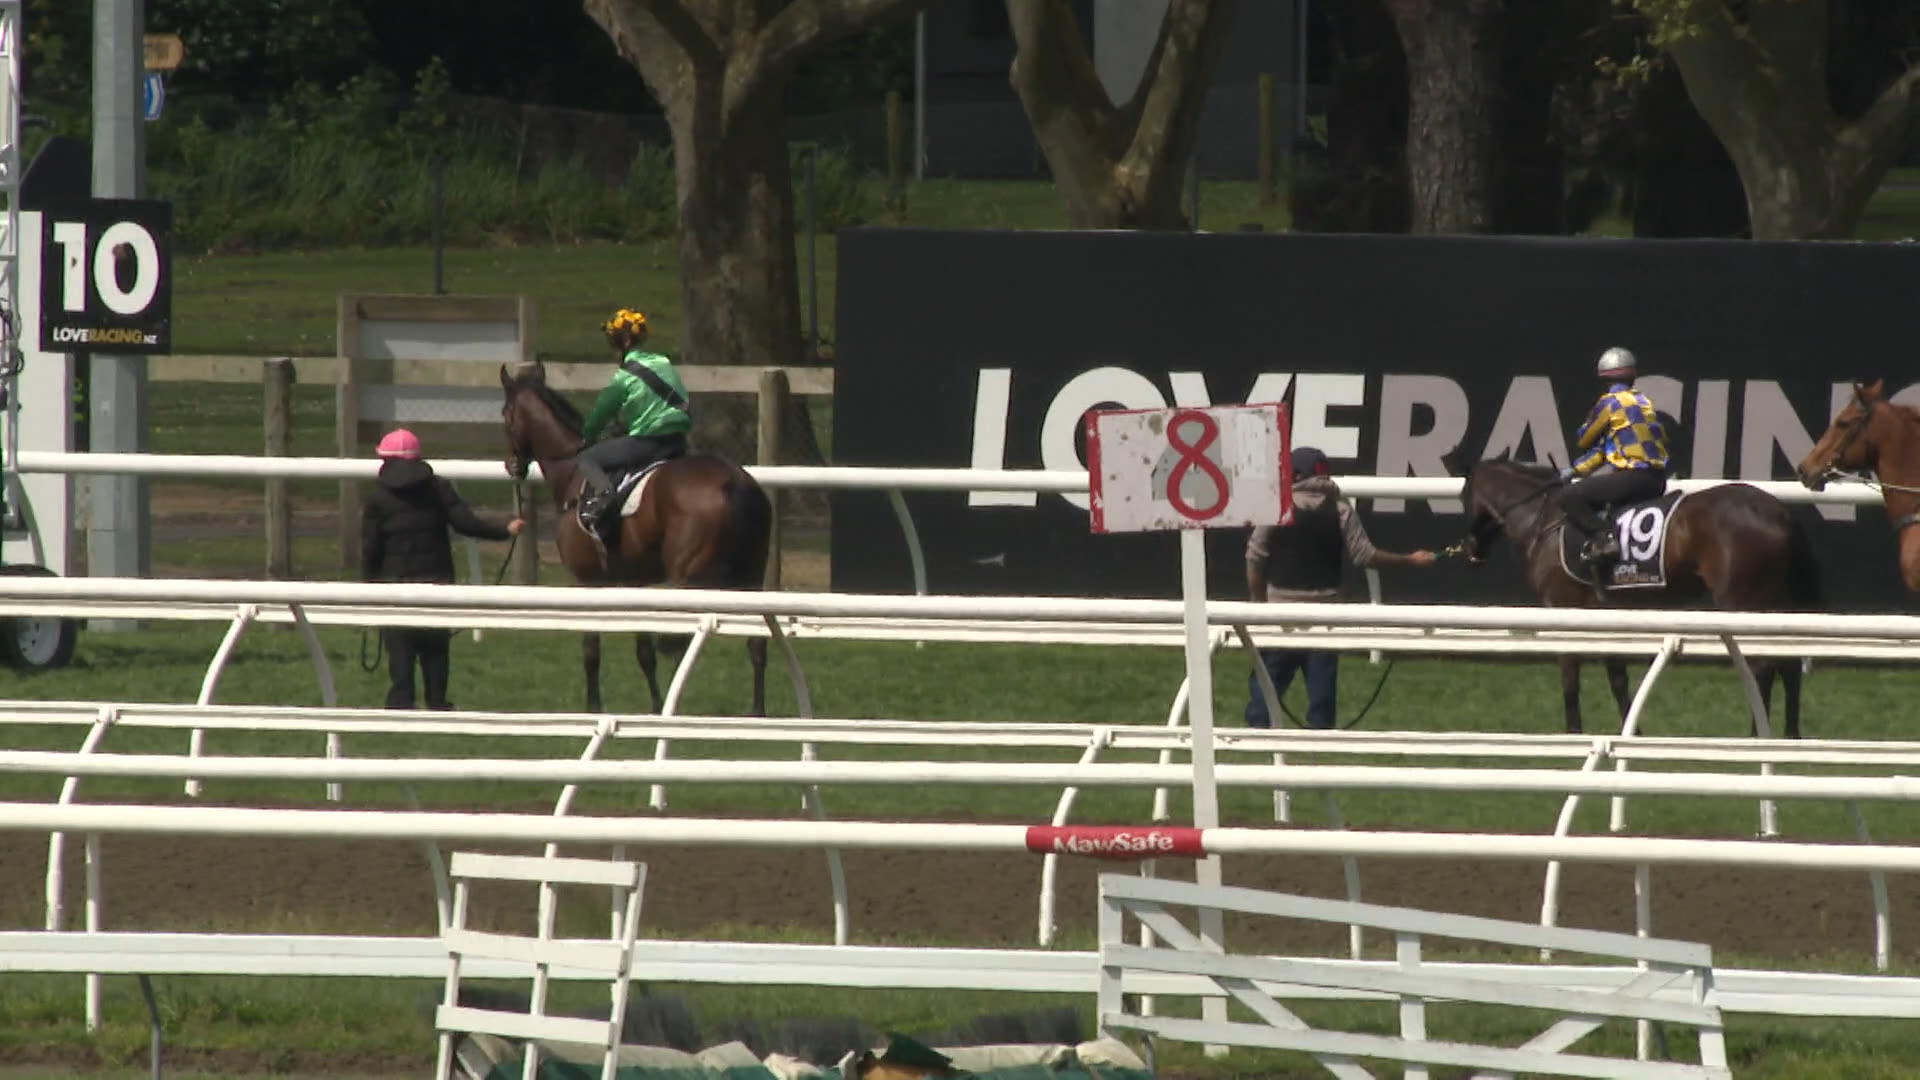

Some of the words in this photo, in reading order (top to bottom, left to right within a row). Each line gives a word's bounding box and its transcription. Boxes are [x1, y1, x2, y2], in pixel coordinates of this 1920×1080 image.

[54, 222, 159, 314] 10
[1167, 410, 1230, 521] 8
[1616, 507, 1664, 561] 19
